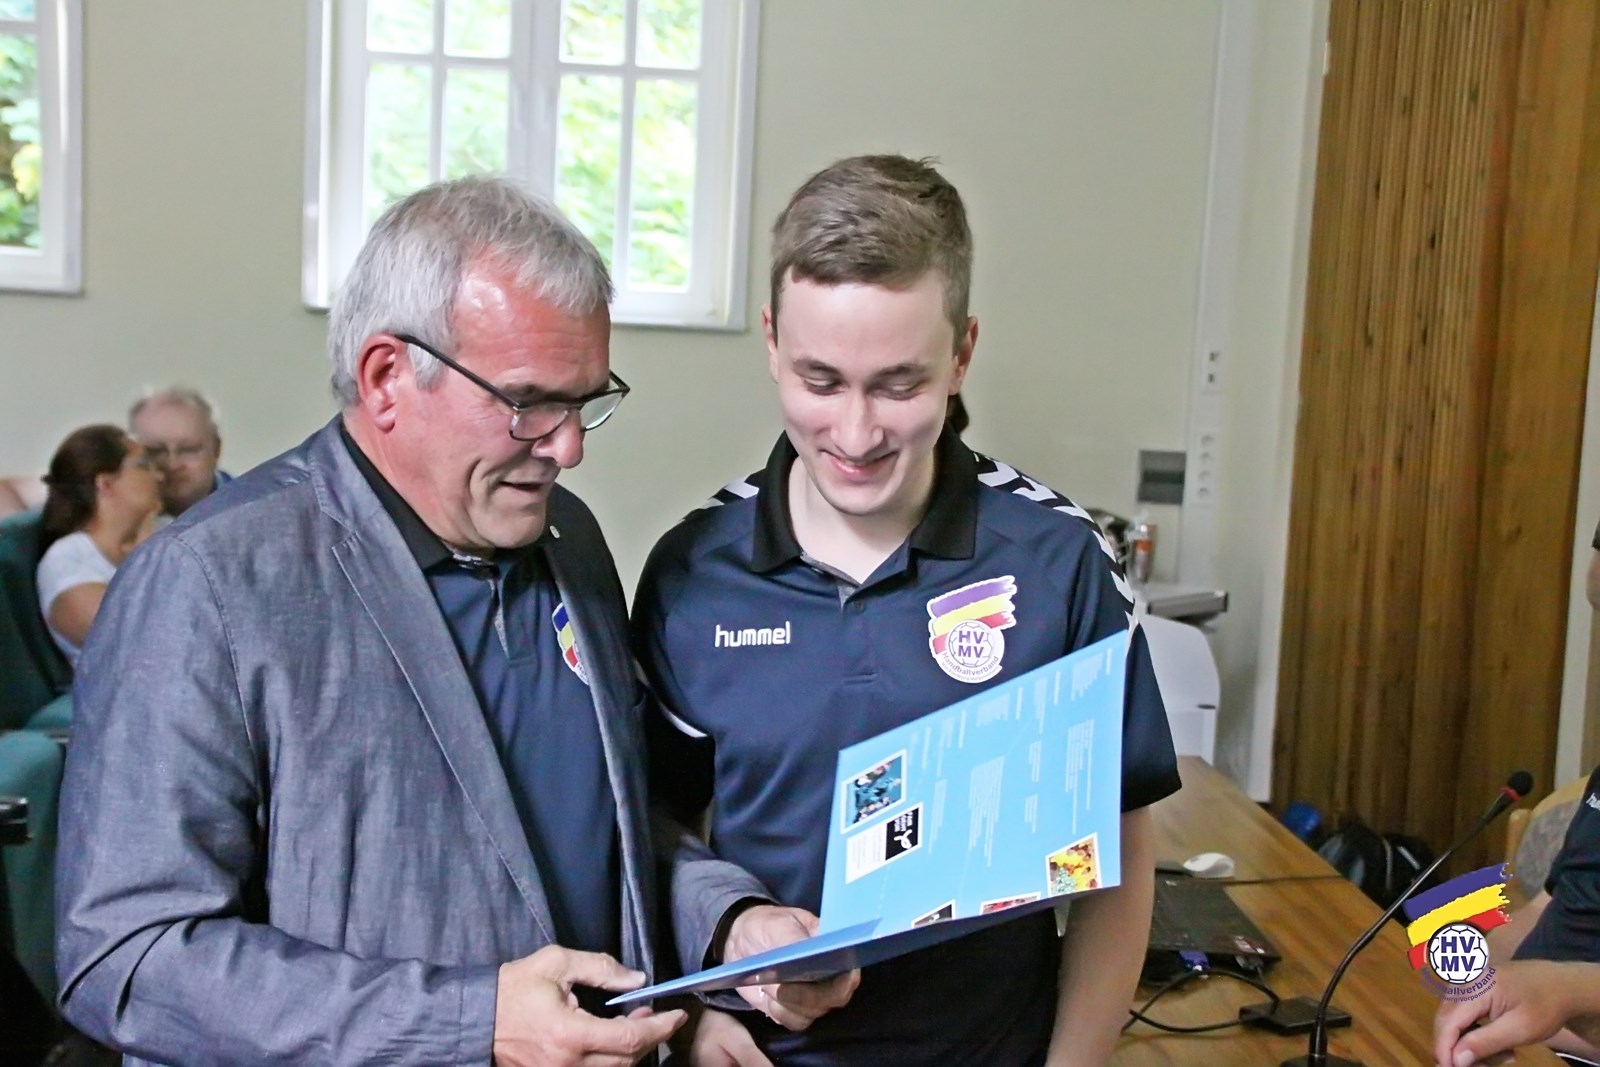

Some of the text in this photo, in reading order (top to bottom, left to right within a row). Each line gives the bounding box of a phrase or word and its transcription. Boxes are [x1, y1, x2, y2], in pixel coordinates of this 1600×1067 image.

[715, 620, 790, 648] hummel
[958, 630, 985, 644] HV
[958, 645, 984, 658] MV
[942, 652, 999, 676] Handballverband
